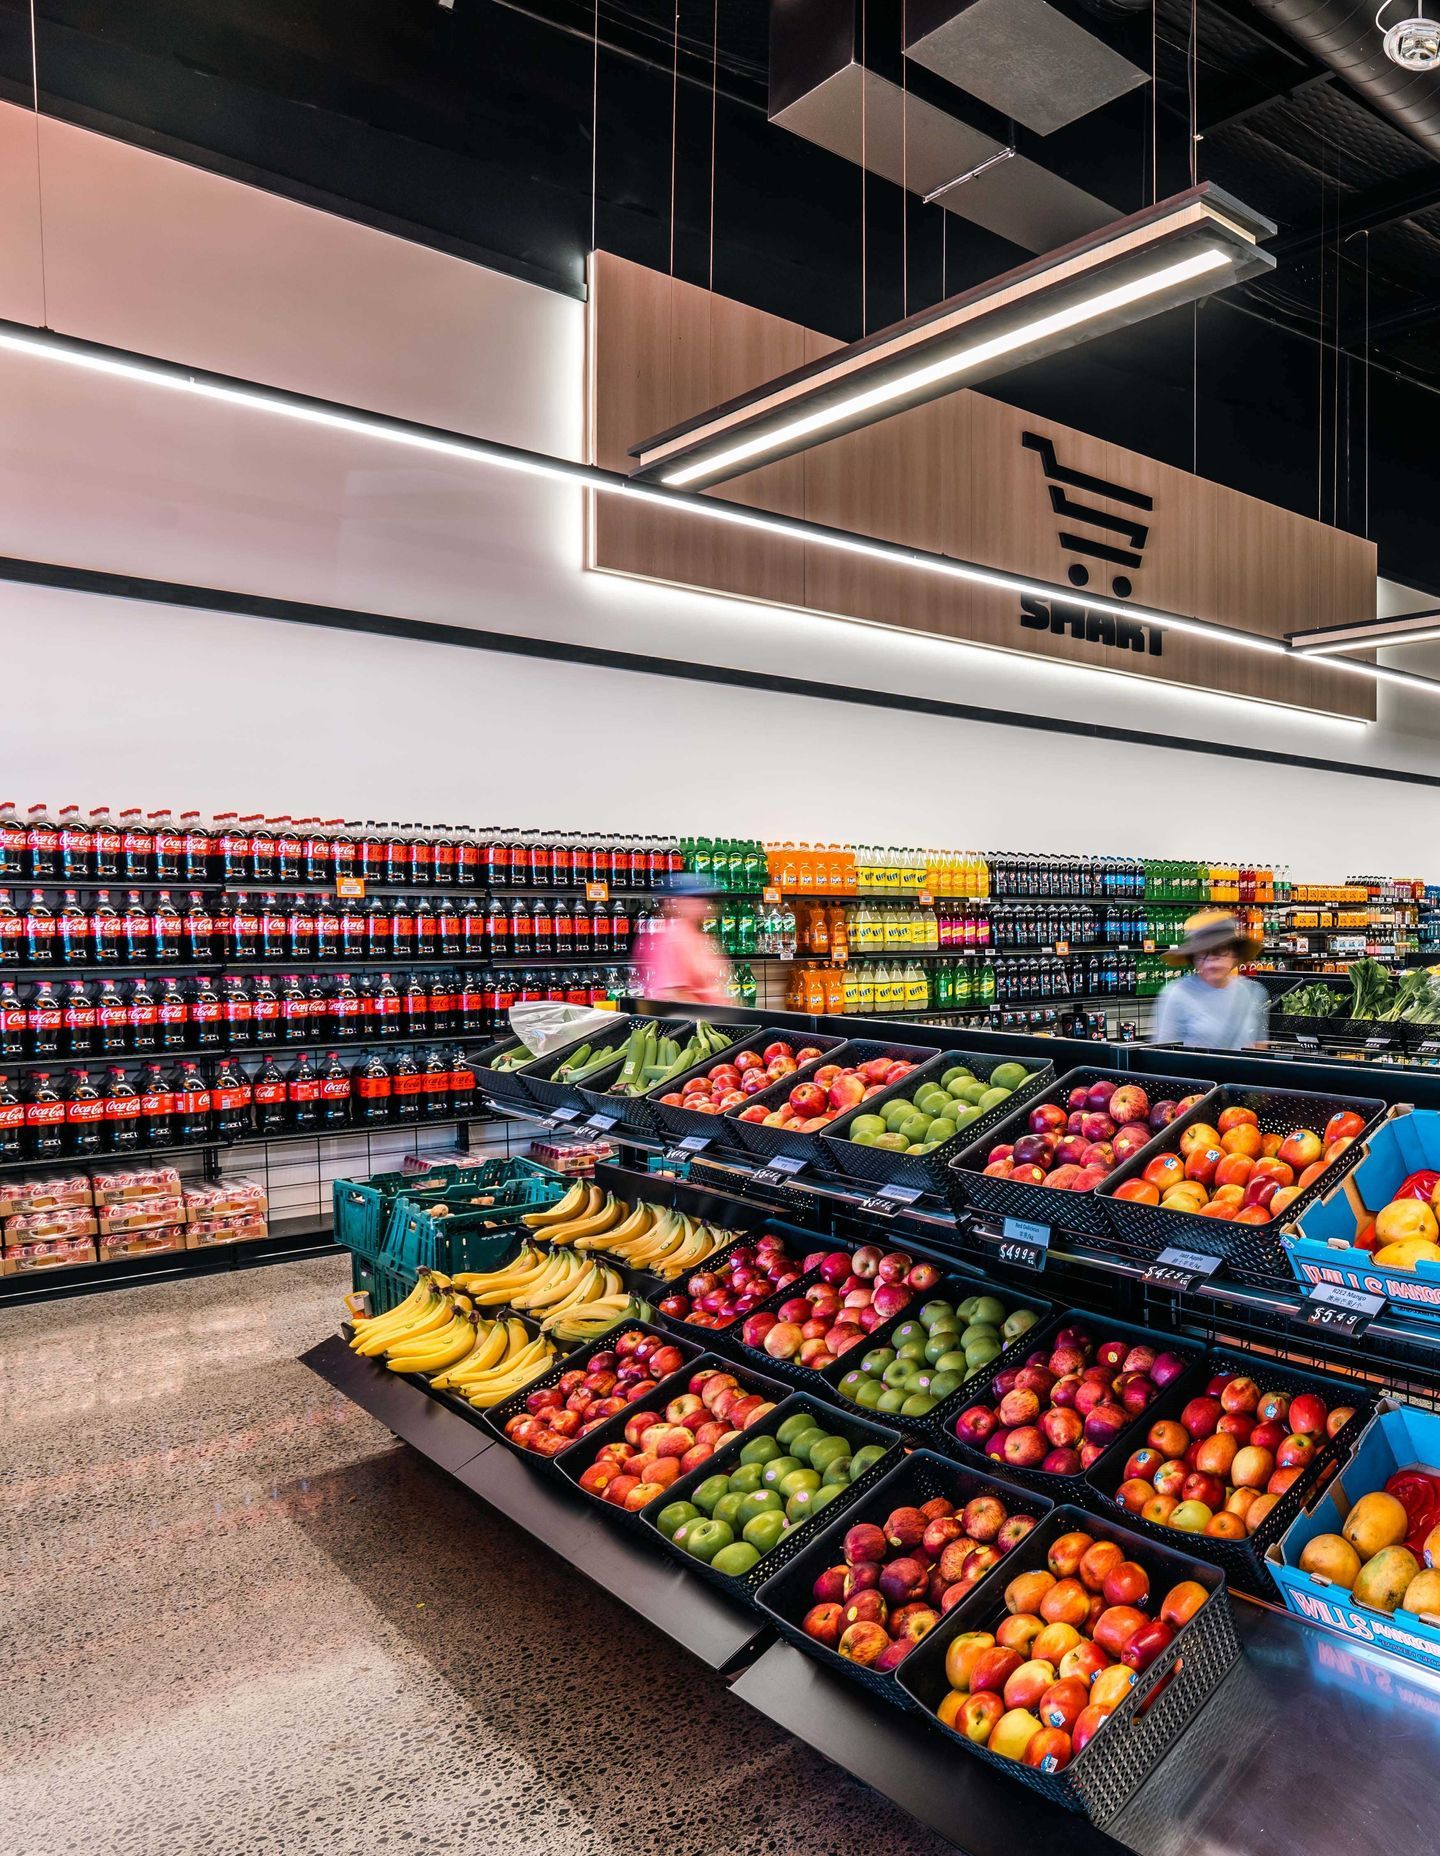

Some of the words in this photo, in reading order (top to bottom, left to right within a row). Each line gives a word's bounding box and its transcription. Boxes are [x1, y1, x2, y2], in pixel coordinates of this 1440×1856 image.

[1347, 1291, 1367, 1301] Mango
[1311, 1306, 1357, 1325] $5.49
[1288, 1588, 1375, 1642] WILLS
